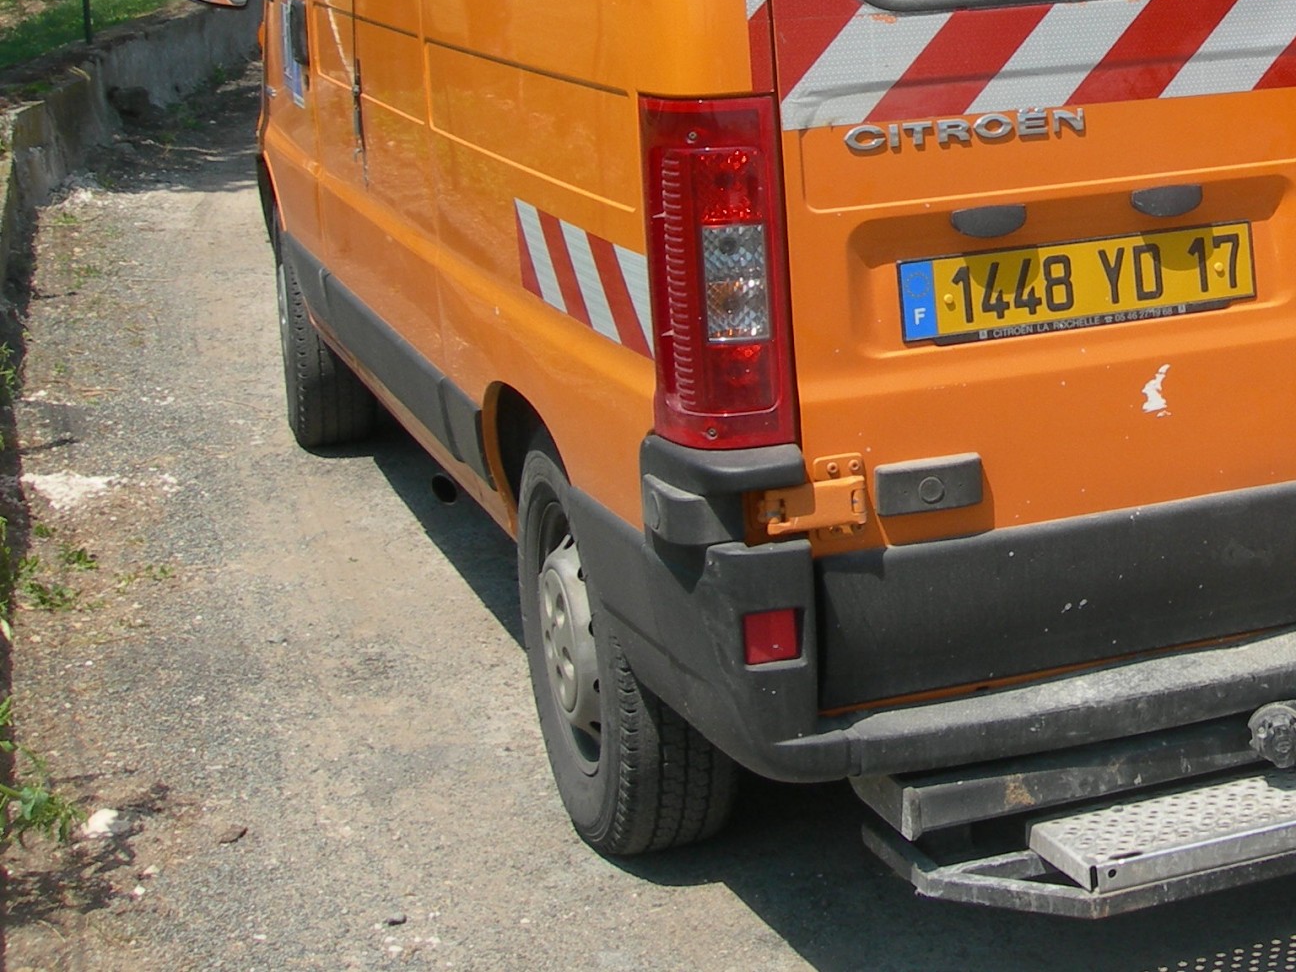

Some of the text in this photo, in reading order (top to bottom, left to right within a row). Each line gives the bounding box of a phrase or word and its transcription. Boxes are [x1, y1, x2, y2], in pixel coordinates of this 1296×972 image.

[843, 107, 1085, 151] CITROËN
[951, 233, 1240, 323] 1448 YD 17
[914, 307, 926, 325] F
[993, 324, 1033, 338] CITROËN
[1037, 323, 1050, 332] LA
[1053, 316, 1100, 330] ROCHELLE
[1115, 314, 1126, 322] 05
[1127, 312, 1138, 320] 46
